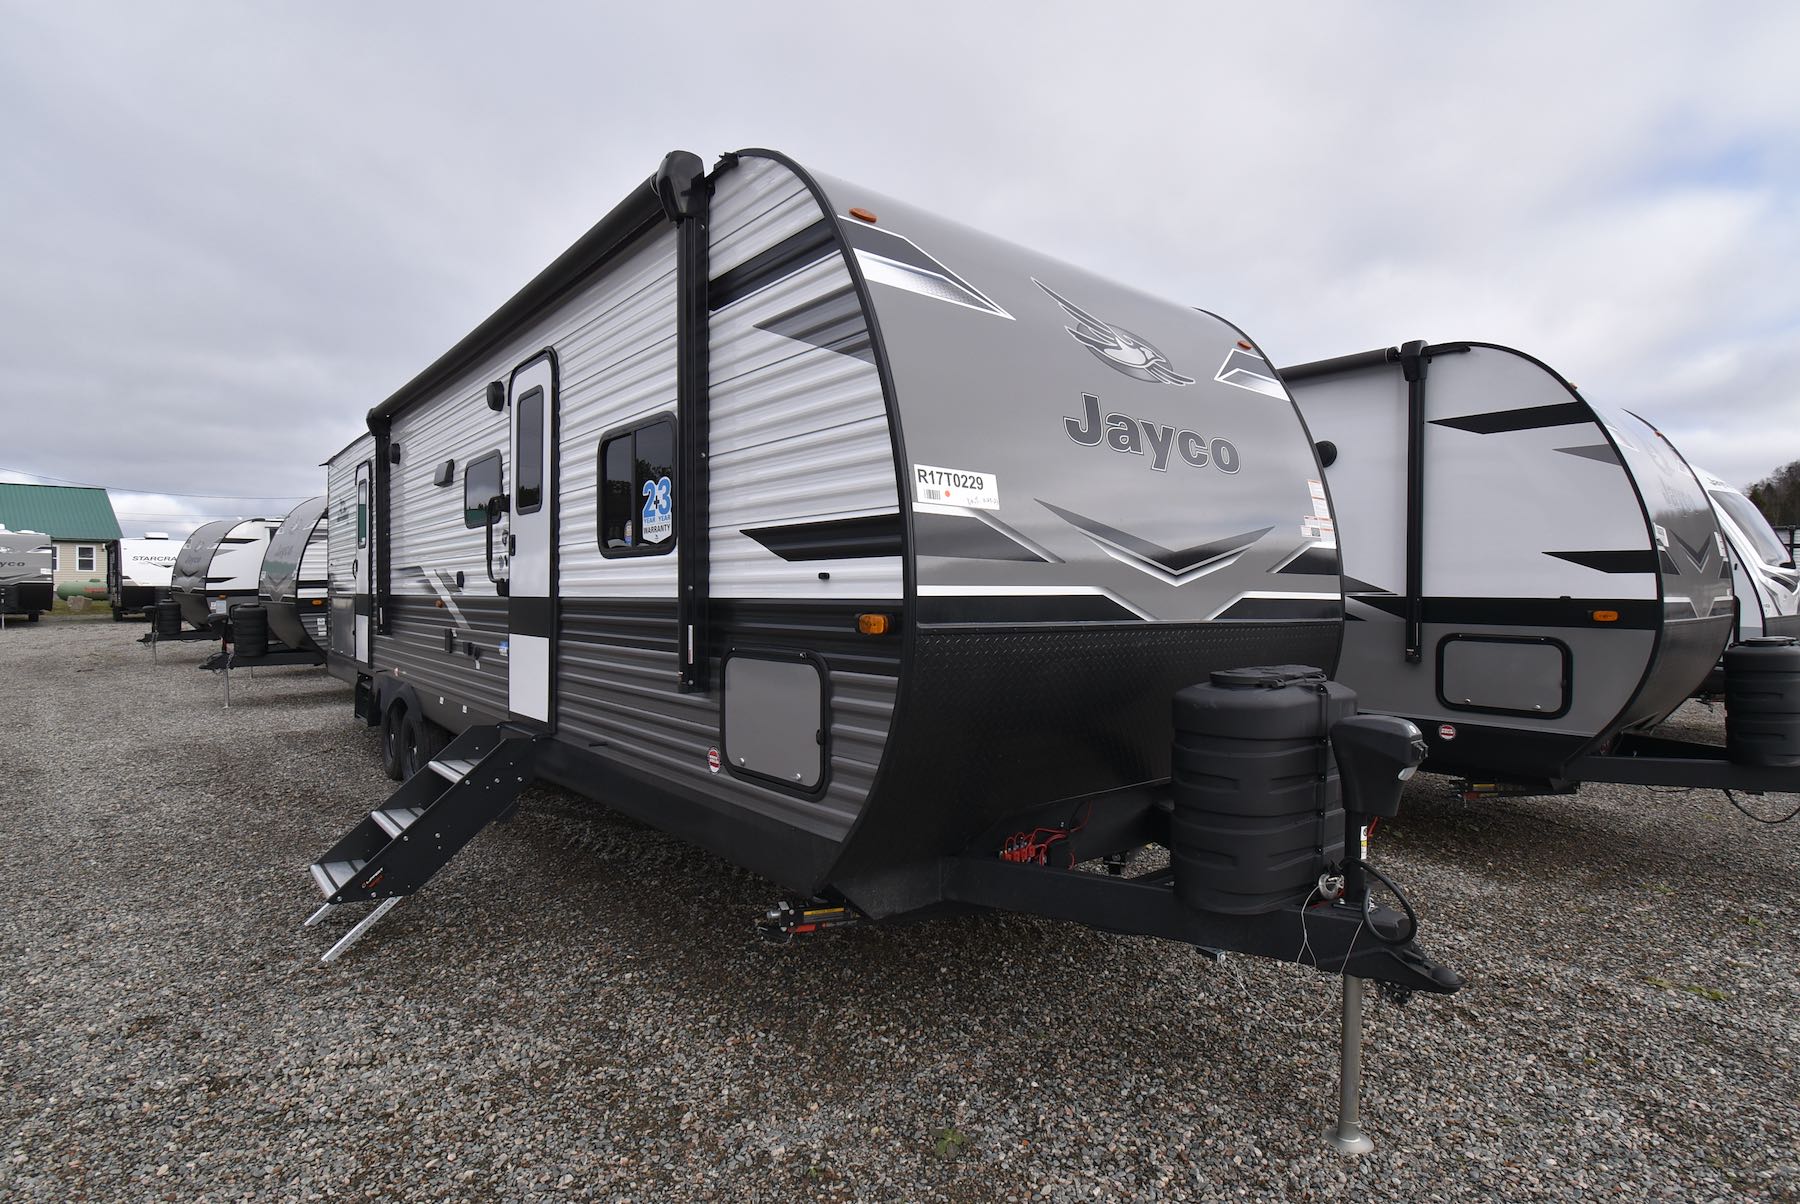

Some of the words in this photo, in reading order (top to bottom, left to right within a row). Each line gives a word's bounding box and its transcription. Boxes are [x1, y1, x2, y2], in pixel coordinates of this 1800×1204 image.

[1063, 392, 1241, 475] Jayco
[917, 468, 985, 491] R17T0229
[658, 514, 671, 523] YEAR
[643, 524, 671, 535] WARRANTY
